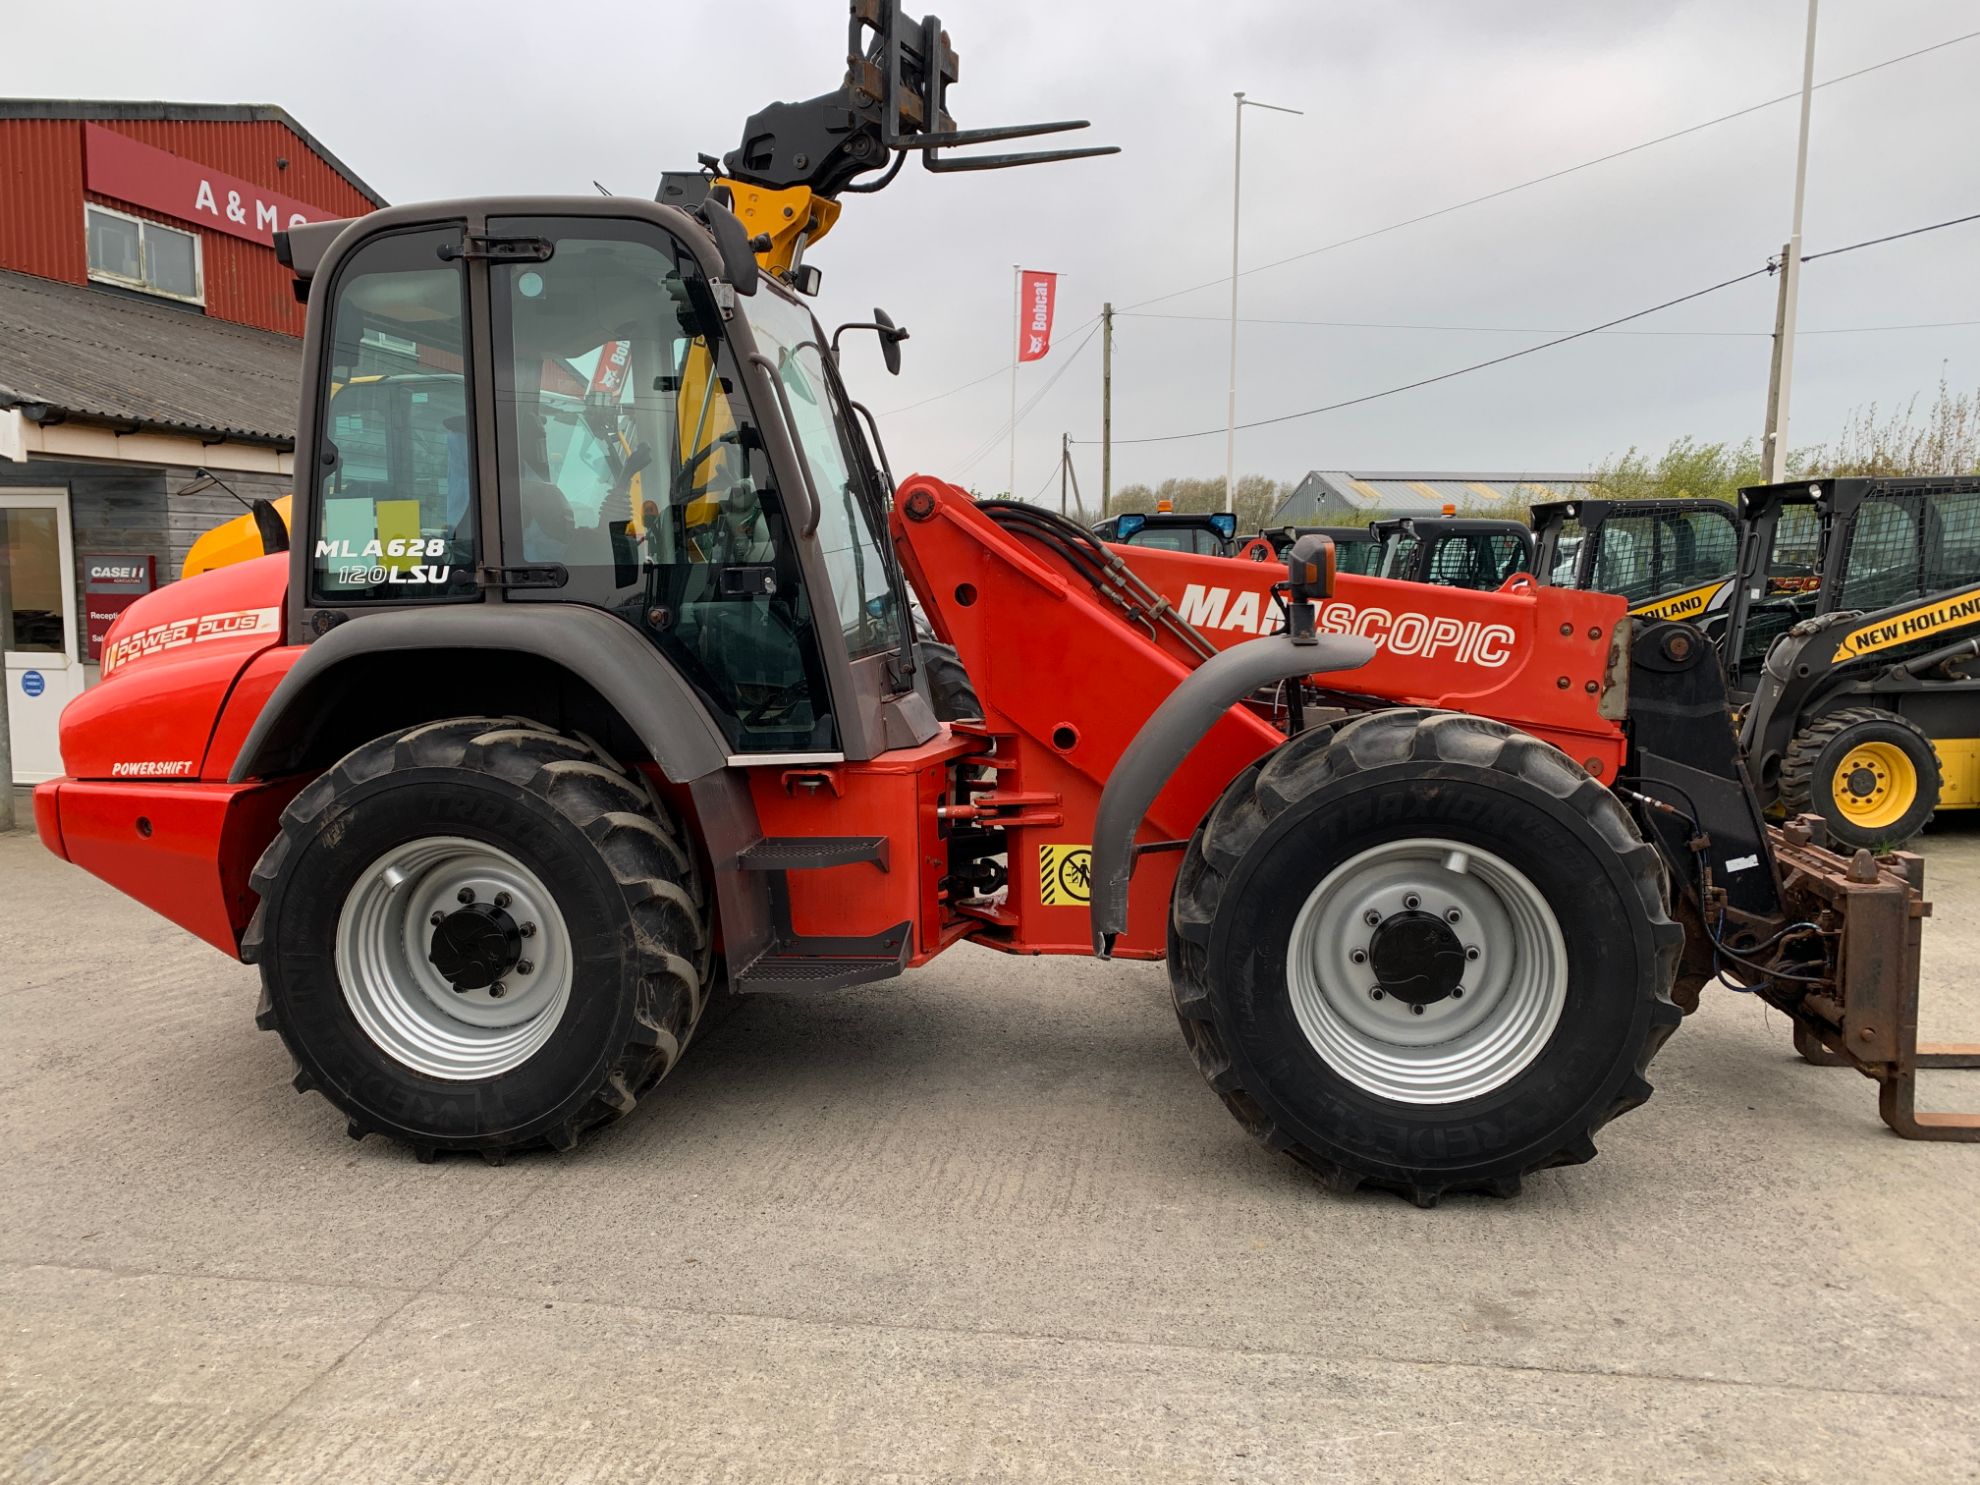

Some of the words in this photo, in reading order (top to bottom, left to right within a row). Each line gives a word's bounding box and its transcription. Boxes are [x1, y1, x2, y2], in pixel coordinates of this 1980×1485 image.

[195, 179, 219, 216] A
[226, 190, 247, 225] &
[256, 198, 278, 233] M
[1031, 281, 1049, 331] Bobcat
[91, 566, 130, 578] CASE
[90, 611, 119, 621] Recepti
[1640, 596, 1702, 619] OLLAND
[92, 634, 104, 642] Sal
[116, 626, 188, 660] POWER
[197, 616, 257, 636] PLUS
[1855, 623, 1898, 649] NEW
[112, 761, 193, 776] POWERSHIFT
